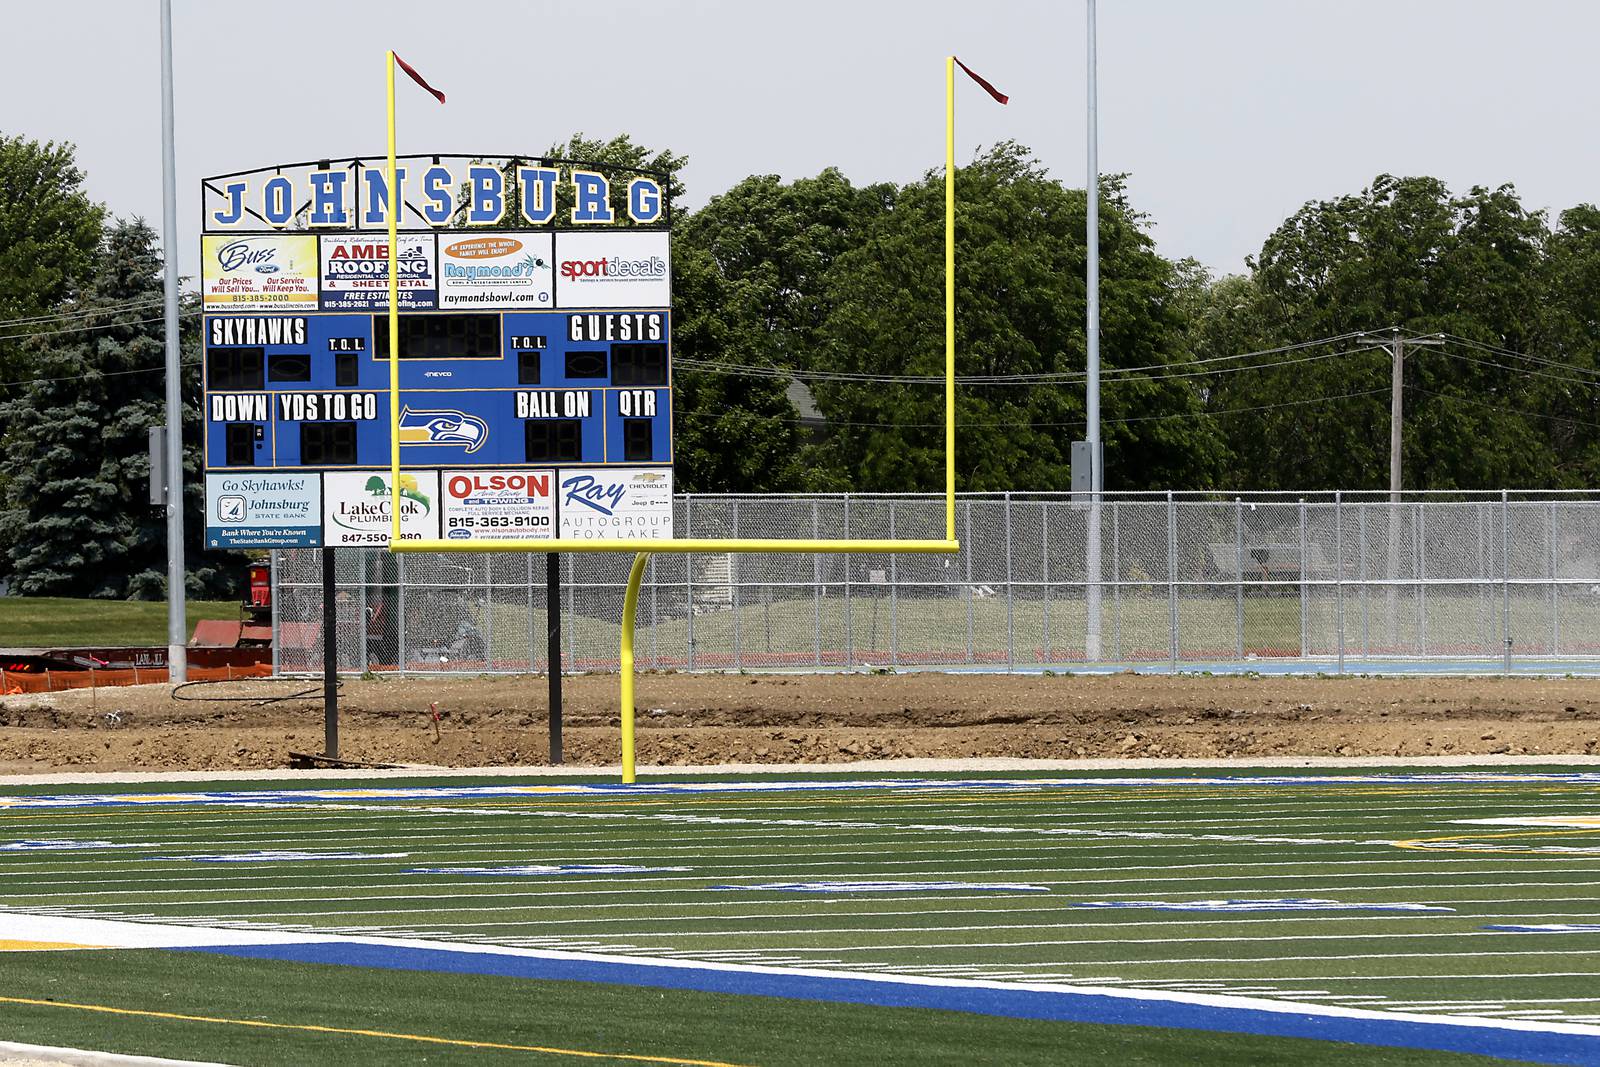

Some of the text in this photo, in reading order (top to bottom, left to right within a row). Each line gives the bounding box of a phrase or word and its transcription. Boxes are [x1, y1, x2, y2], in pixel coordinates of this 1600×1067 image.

[212, 164, 662, 227] JOHNSBURG
[218, 244, 277, 272] Buss
[331, 244, 390, 260] AMB
[258, 265, 276, 273] Ford
[329, 260, 427, 274] ROOFNG
[444, 262, 534, 281] Raymond's
[560, 256, 666, 282] sportdecals
[232, 277, 253, 285] Prices
[266, 276, 305, 285] Our Service
[328, 280, 336, 288] &
[226, 285, 241, 293] Sell
[262, 285, 309, 294] Will Keep You.
[344, 291, 413, 300] FREE ESTITES
[232, 294, 289, 302] 815-385-2000
[374, 300, 433, 309] ambofing.com
[444, 291, 534, 305] raymondsbowl.com
[212, 318, 305, 345] SKYHAWKS
[571, 314, 661, 341] GUESTS
[212, 394, 268, 421] DOWN
[280, 393, 376, 421] YDS TO GO
[516, 391, 589, 418] BALL ON
[619, 390, 656, 417] QTR
[222, 479, 305, 494] Go Skyhawks!
[448, 475, 549, 499] OLSON
[562, 475, 626, 516] Ray
[248, 499, 311, 512] Johnsburg
[350, 515, 409, 523] PLUMBIG
[448, 516, 550, 528] 815-363-9100
[562, 517, 671, 527] AUTOGROUP
[341, 533, 422, 542] 847-550-880
[573, 529, 660, 539] FOX LAKE
